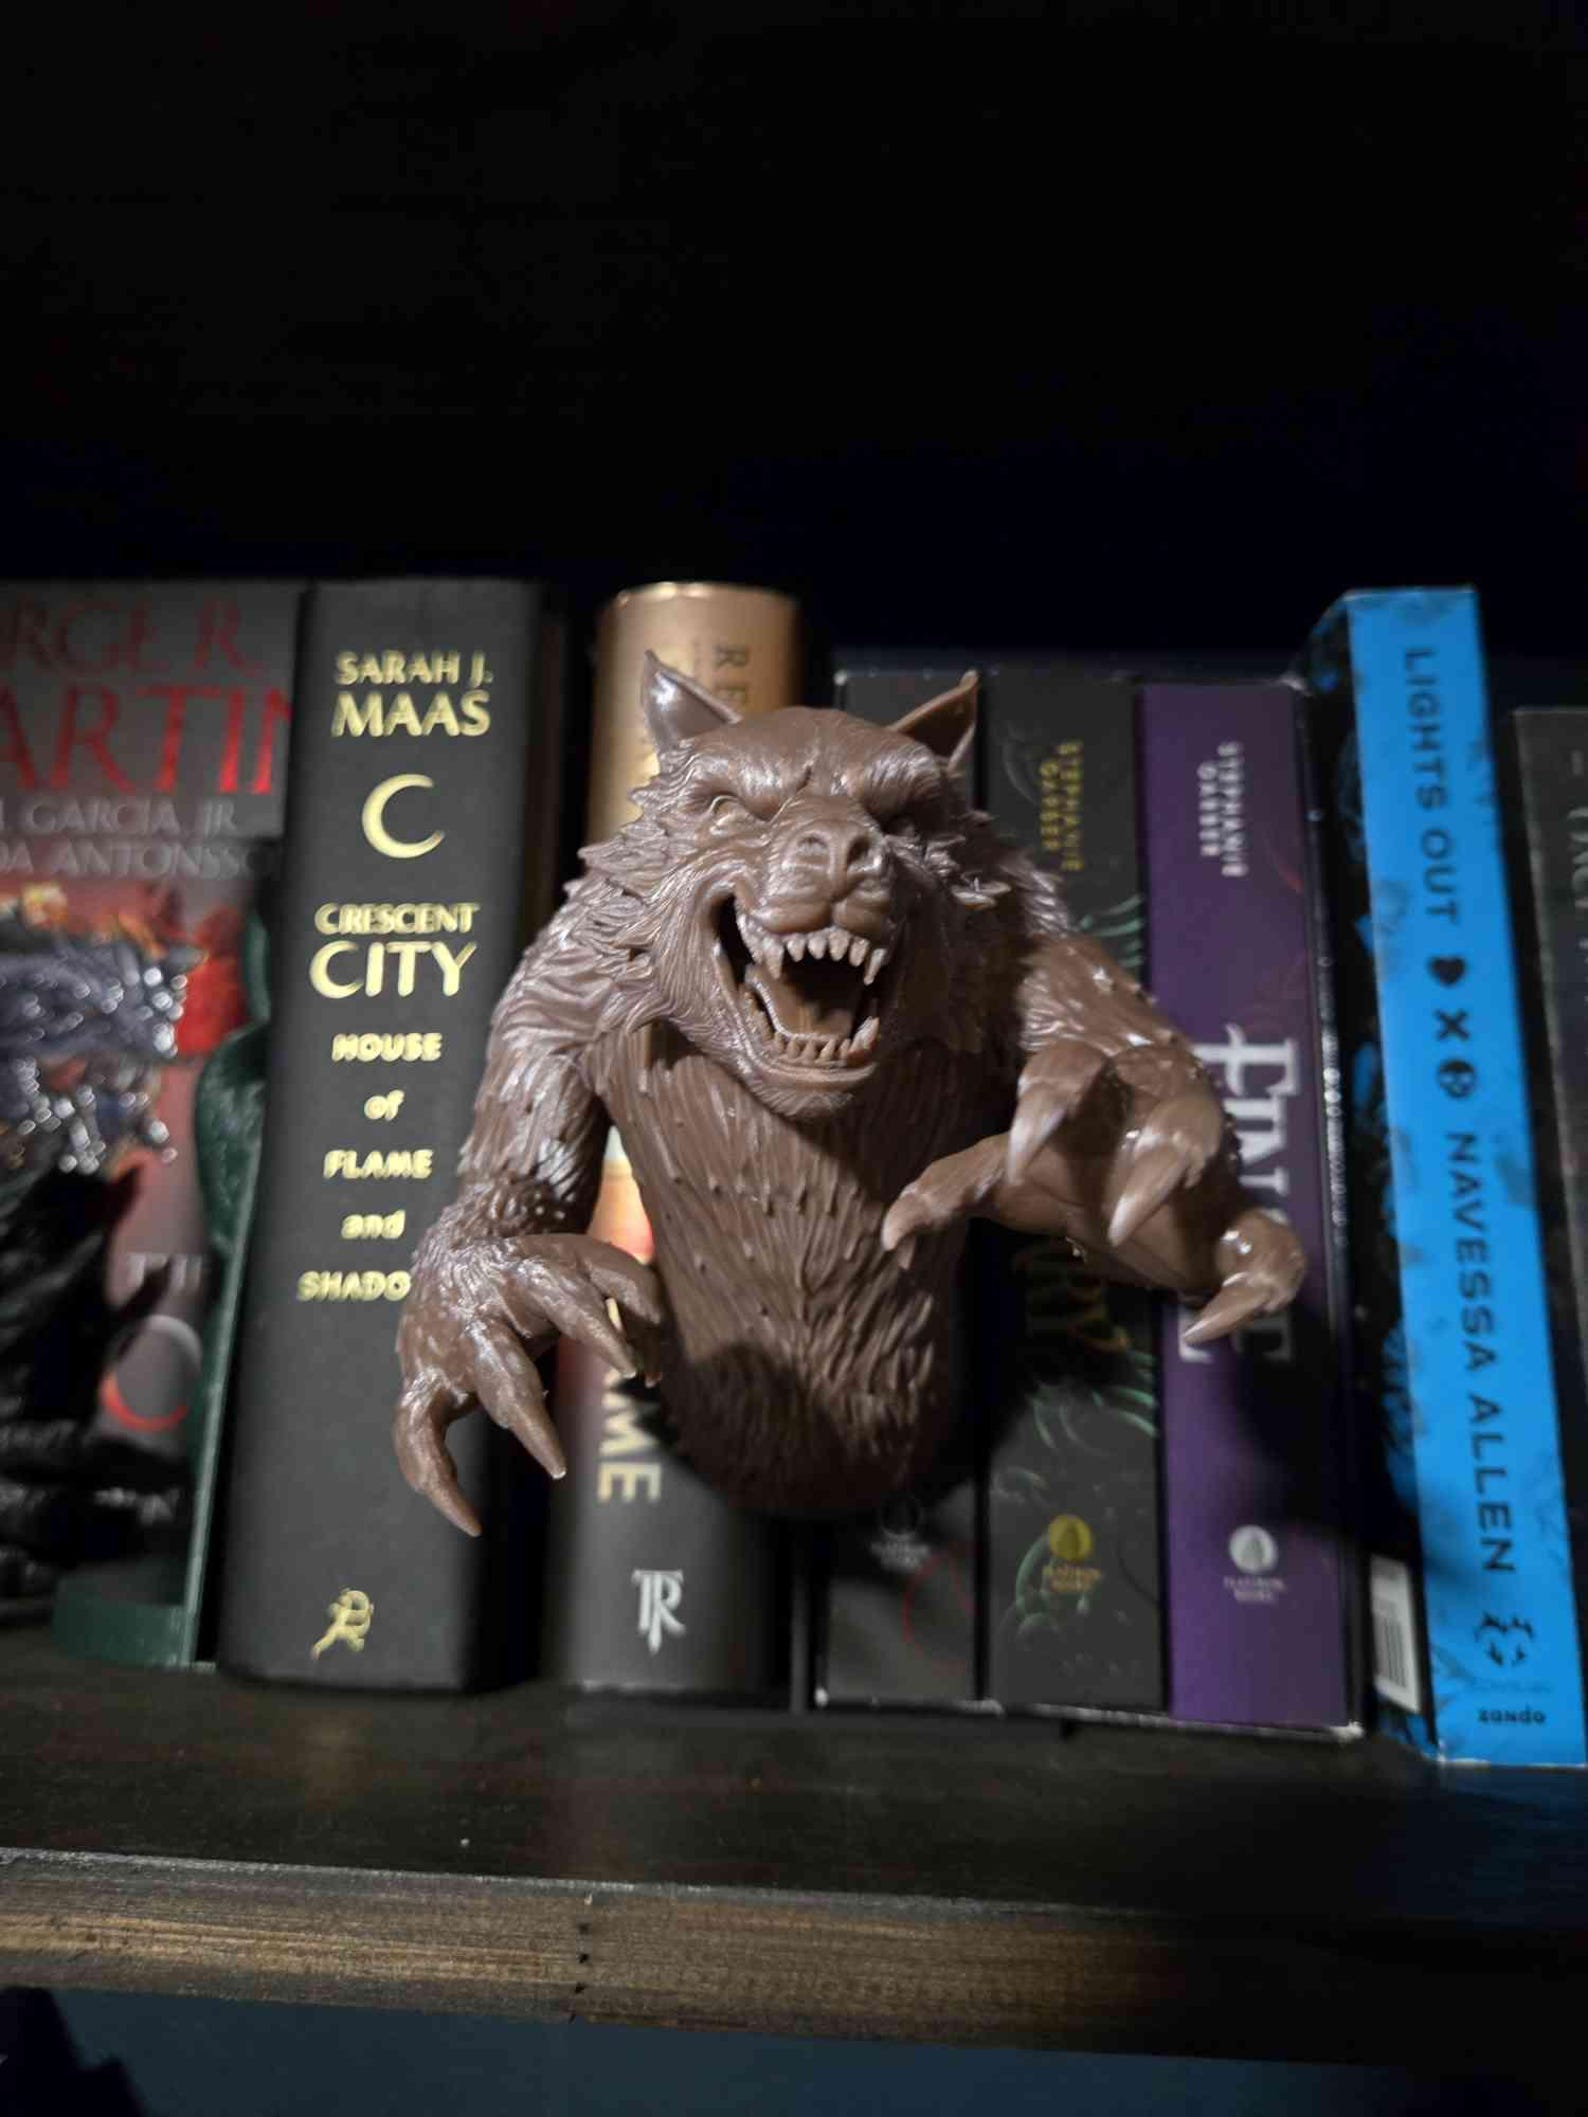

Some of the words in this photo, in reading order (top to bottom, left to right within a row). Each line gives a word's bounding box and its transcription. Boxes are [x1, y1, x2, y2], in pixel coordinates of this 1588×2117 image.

[336, 650, 461, 686] SARAH
[331, 692, 493, 738] MAAS
[1405, 647, 1450, 811] LIGHTS
[1420, 827, 1460, 926] OUT
[314, 903, 483, 936] CRESCENT
[309, 941, 478, 999] CITY
[331, 1032, 443, 1062] HOUSE
[363, 1089, 405, 1121] of
[323, 1149, 434, 1180] FLAME
[340, 1209, 406, 1240] and
[1445, 1131, 1498, 1373] NAVESSA
[297, 1270, 412, 1302] SHADO
[1466, 1392, 1517, 1576] ALLEN
